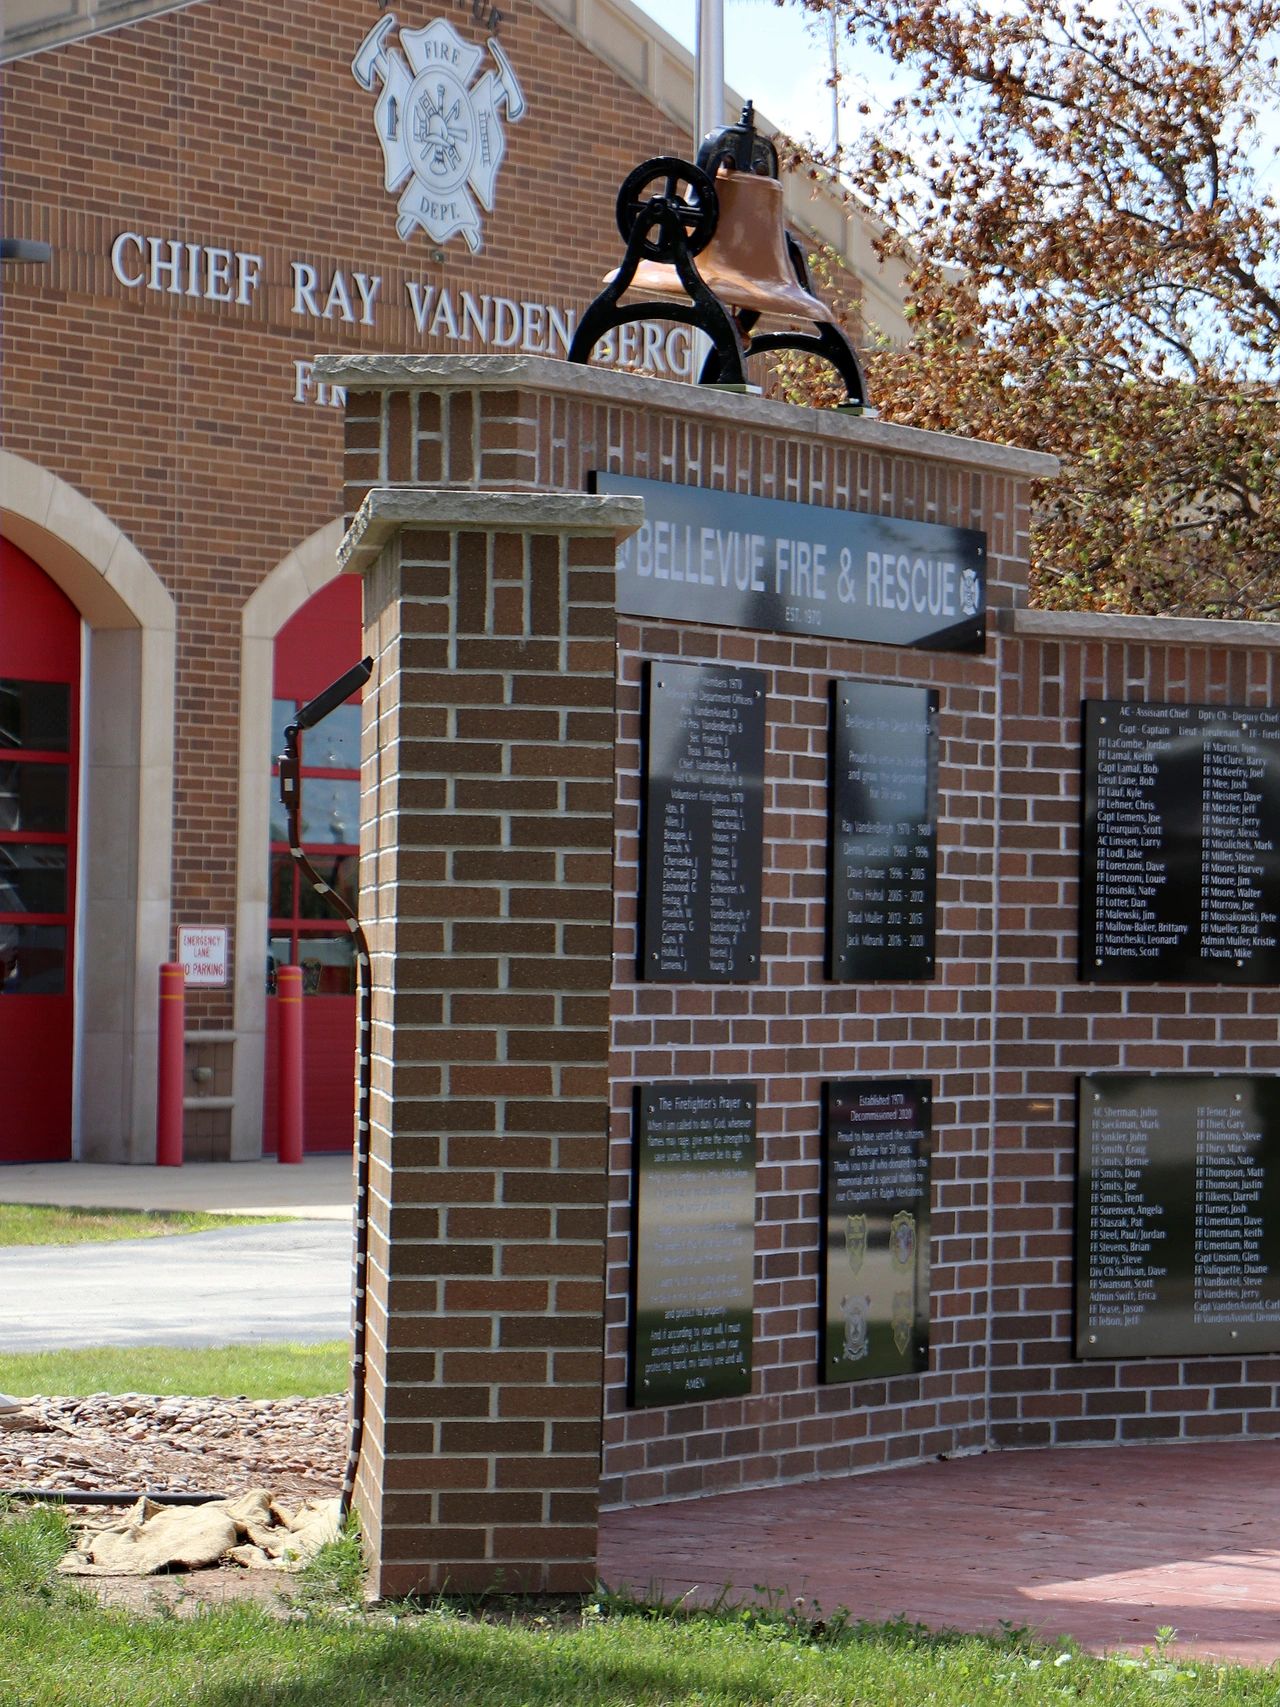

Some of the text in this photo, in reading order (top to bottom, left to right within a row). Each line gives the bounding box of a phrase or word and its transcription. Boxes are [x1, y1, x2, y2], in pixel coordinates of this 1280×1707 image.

[424, 40, 461, 67] FIRE
[420, 196, 460, 221] DEPT.
[111, 231, 263, 305] CHIEF
[291, 262, 381, 325] RAY
[637, 520, 955, 615] BELLEVUE FIRE & RESCUE
[1203, 778, 1248, 790] FF Mee, Josh
[1098, 787, 1105, 796] FF
[1127, 788, 1143, 798] Kyle
[1097, 811, 1161, 824] Capt Lemens, Joe
[1097, 823, 1105, 832] FF
[1143, 825, 1162, 835] Scott
[1098, 836, 1107, 845] AC
[1141, 838, 1161, 847] Larry
[1202, 839, 1210, 848] FF
[1254, 840, 1273, 850] Mark
[1097, 848, 1105, 857] FF
[1127, 849, 1143, 859] Jake
[1097, 860, 1105, 869] FF
[1146, 862, 1165, 871] Dave
[1202, 887, 1261, 898] FF Moore, Walter
[1096, 897, 1147, 907] FF Lotter, Dan
[1201, 911, 1208, 921] FF
[1261, 913, 1277, 922] Pete
[1096, 922, 1104, 931] FF
[1158, 923, 1188, 933] Brittany
[184, 936, 220, 946] EMERGENCY
[1201, 936, 1225, 945] Admin
[1253, 937, 1276, 946] Kristie
[194, 947, 209, 958] LANE
[193, 963, 223, 976] PARKING
[659, 1098, 672, 1110] The
[719, 1096, 741, 1112] Prayer
[859, 1094, 904, 1106] Established 1970
[1092, 1169, 1141, 1178] FF Smits, Don
[1196, 1168, 1264, 1178] FF Thompson, Matt
[1091, 1206, 1163, 1216] FF Sorensen, Angela
[1196, 1204, 1247, 1214] FF Turner, Josh
[1195, 1228, 1263, 1238] FF Umentum, Keith
[1090, 1242, 1151, 1252] FF Stevens, Brian
[1195, 1253, 1212, 1264] Capt
[1242, 1252, 1260, 1261] Glen
[685, 1376, 705, 1389] AMEN
